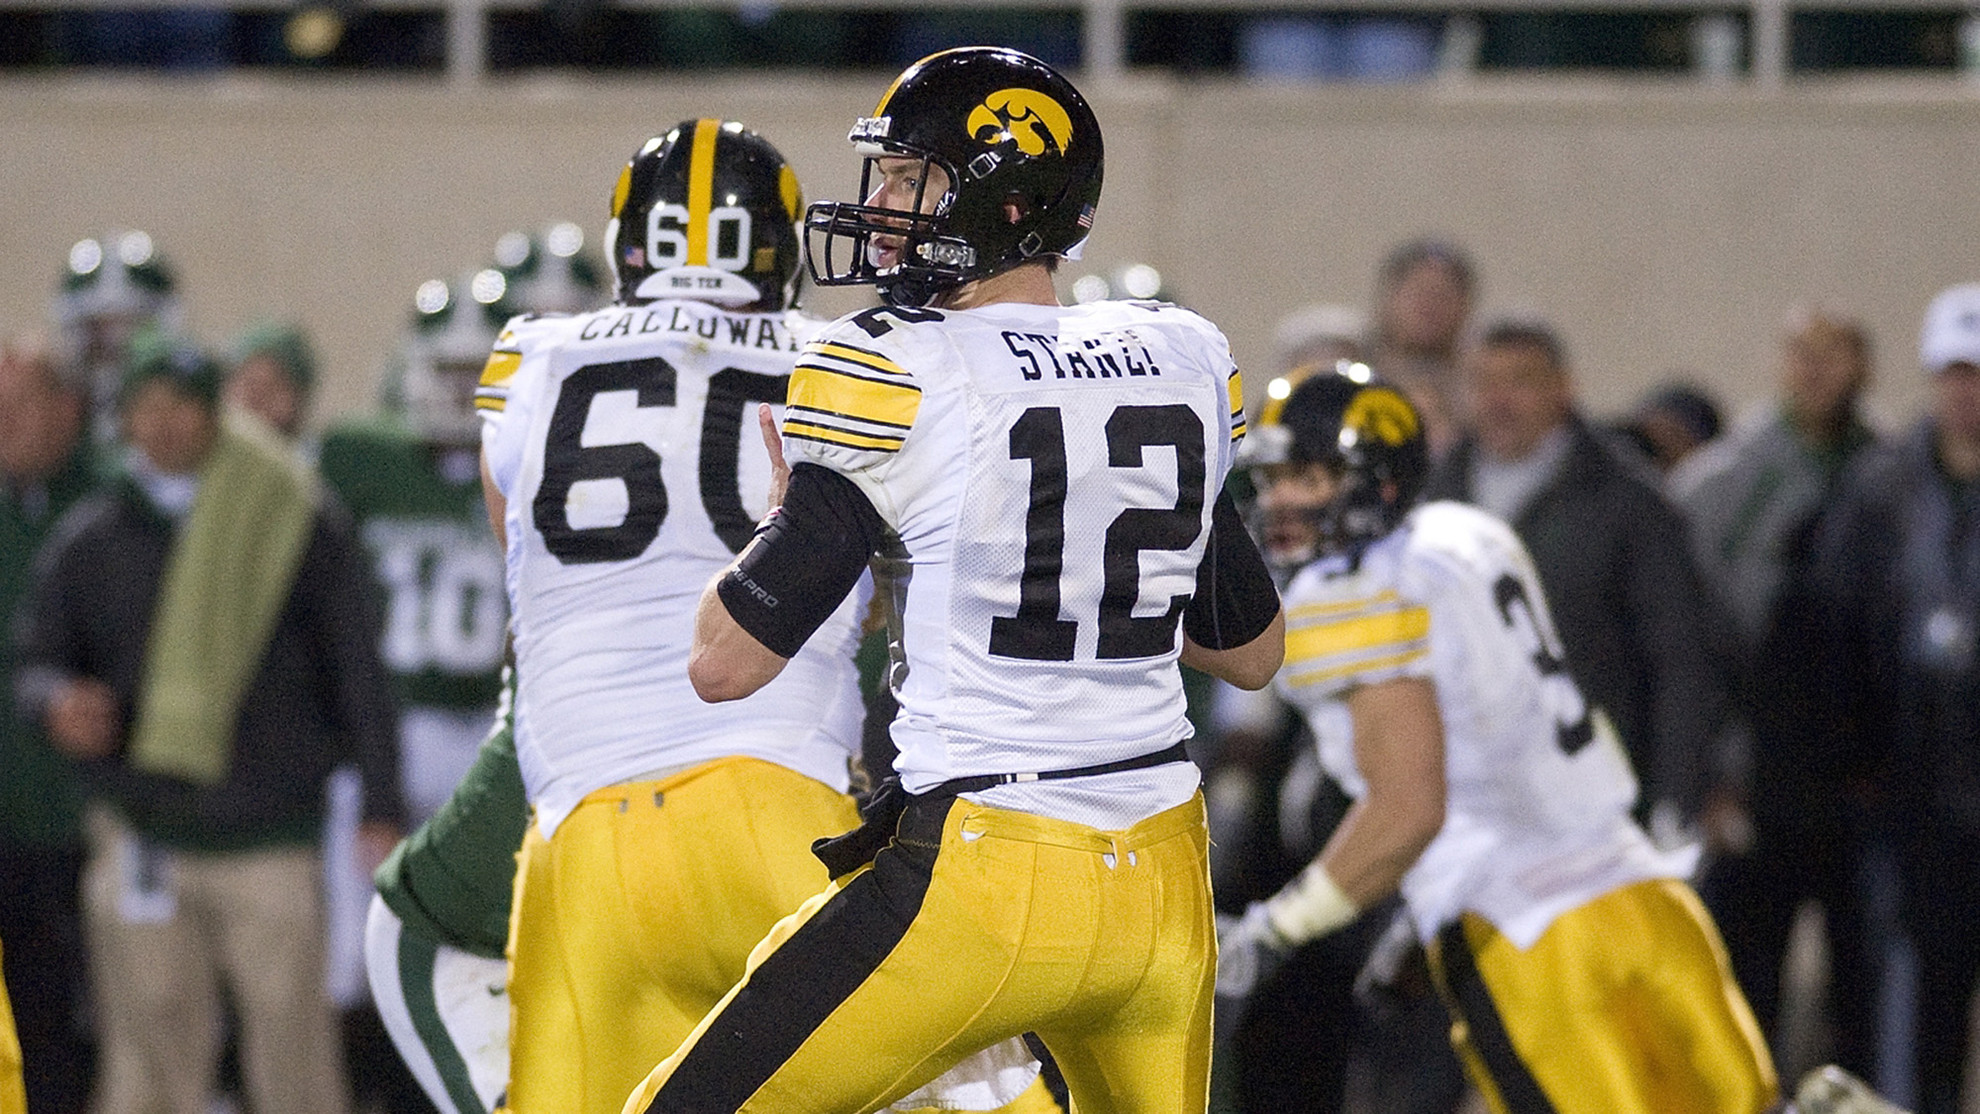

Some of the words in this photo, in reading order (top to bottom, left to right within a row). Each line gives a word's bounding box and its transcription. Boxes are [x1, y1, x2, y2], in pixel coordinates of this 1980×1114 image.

[647, 204, 751, 271] 60
[533, 357, 791, 565] 60
[988, 404, 1206, 661] 12
[374, 538, 506, 672] 10
